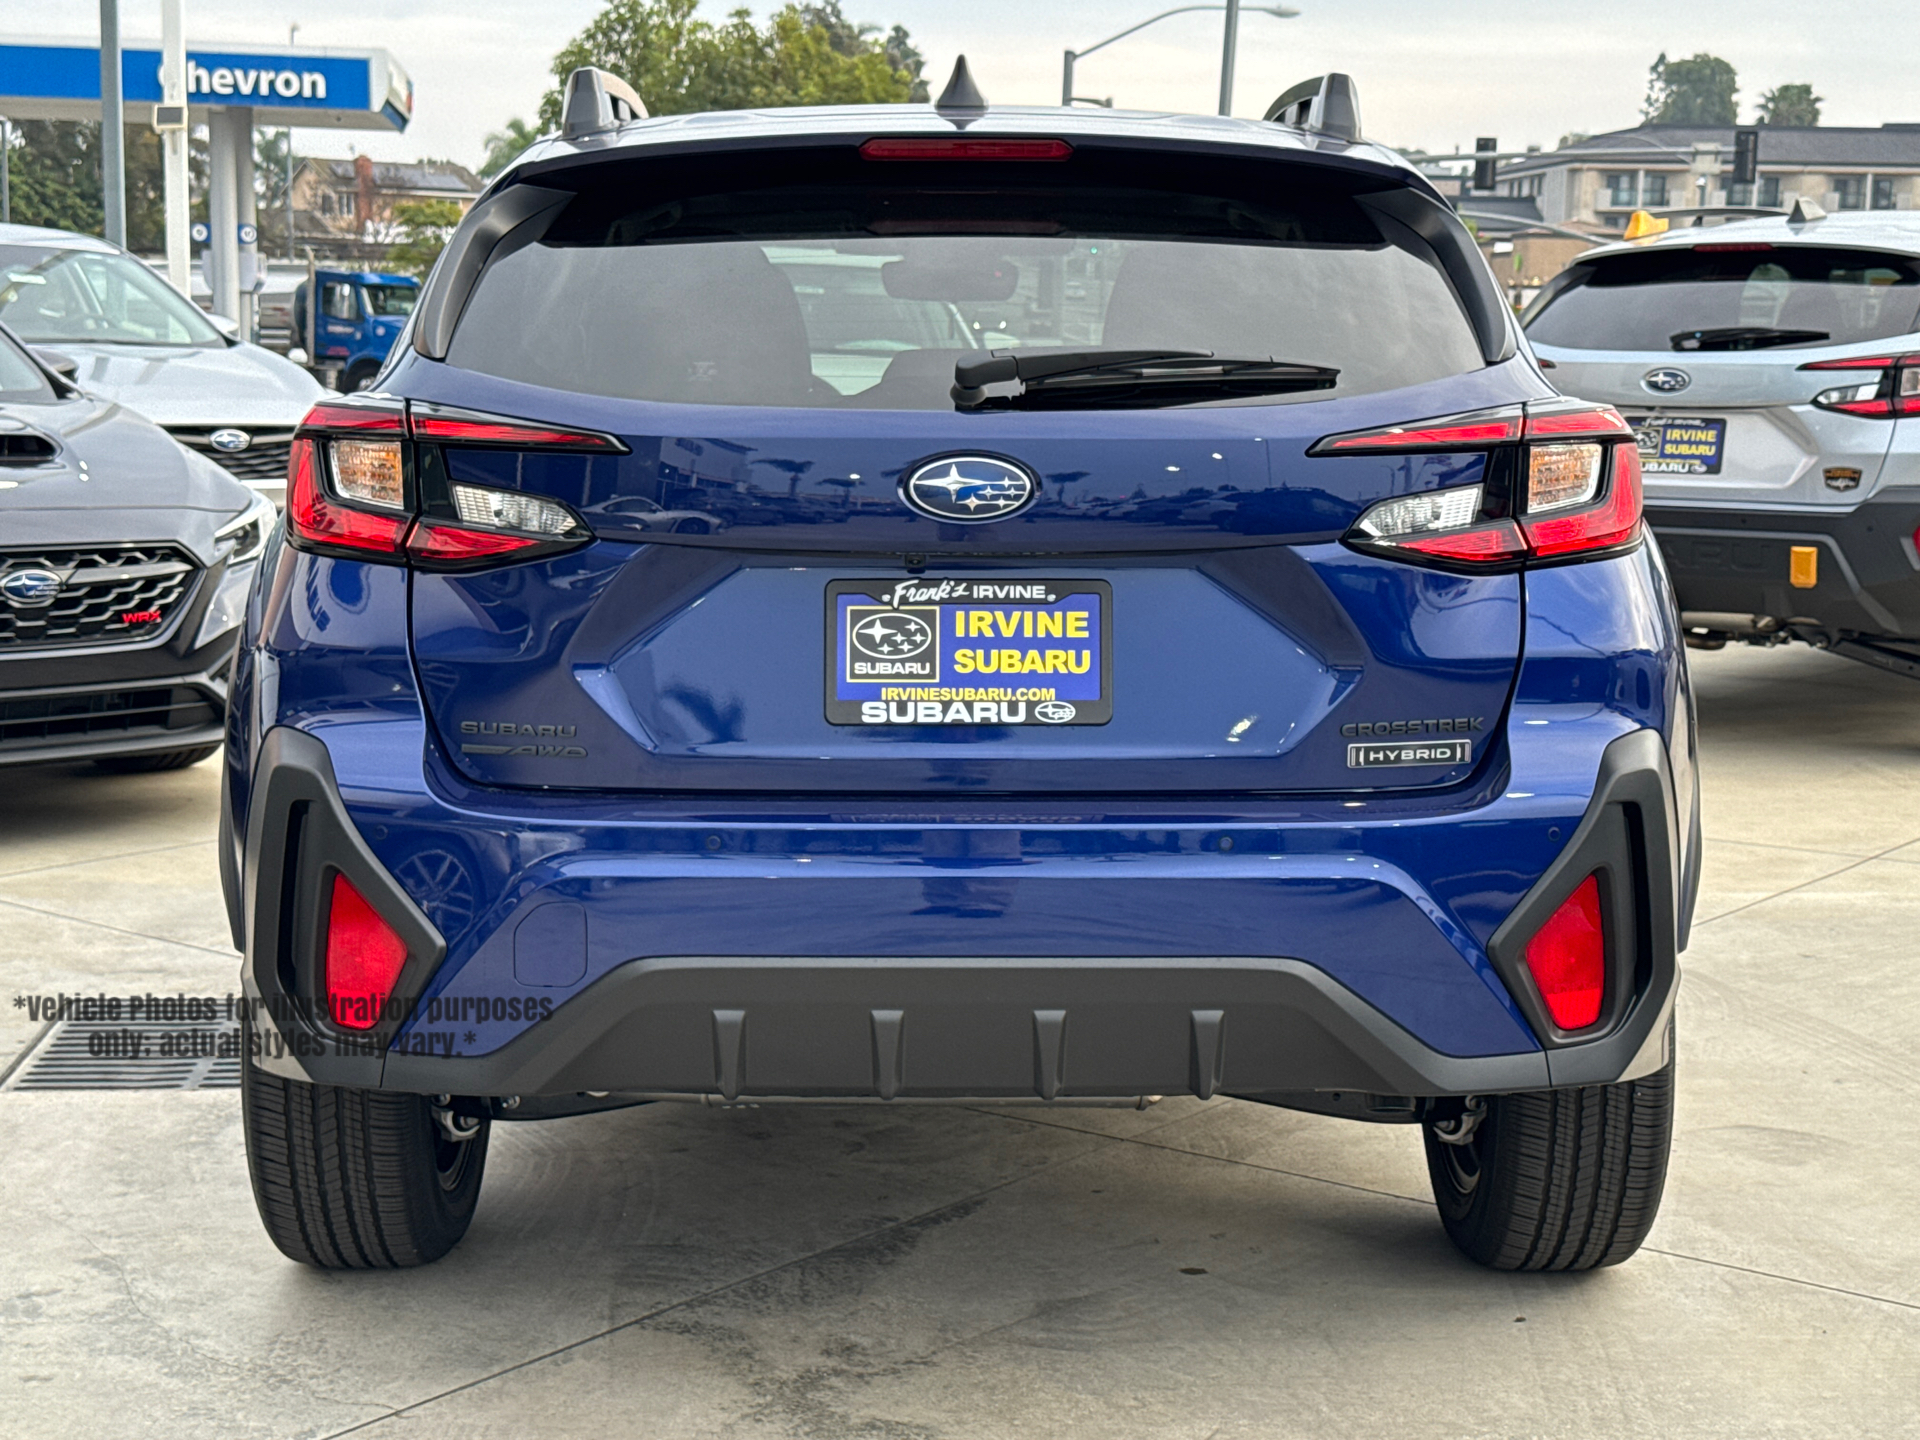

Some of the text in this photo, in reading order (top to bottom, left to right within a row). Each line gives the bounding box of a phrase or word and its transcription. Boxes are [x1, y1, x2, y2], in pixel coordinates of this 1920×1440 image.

[157, 60, 327, 99] hevron
[1666, 428, 1717, 443] IRVINE
[1664, 443, 1716, 457] SUBARU
[1640, 461, 1689, 473] UBARU
[892, 579, 1047, 609] Frank's IRVINE
[122, 610, 162, 624] WRX
[955, 611, 1090, 639] IRVINE
[854, 662, 931, 675] SUBARU
[953, 648, 1091, 675] SUBARU
[881, 687, 1056, 702] IRVINESUBARU.COM
[861, 701, 1027, 724] SUBARU
[460, 721, 578, 738] SUBARU
[1340, 717, 1485, 738] CROSSTREK
[507, 744, 589, 758] AWD
[1369, 748, 1452, 762] HYBRID
